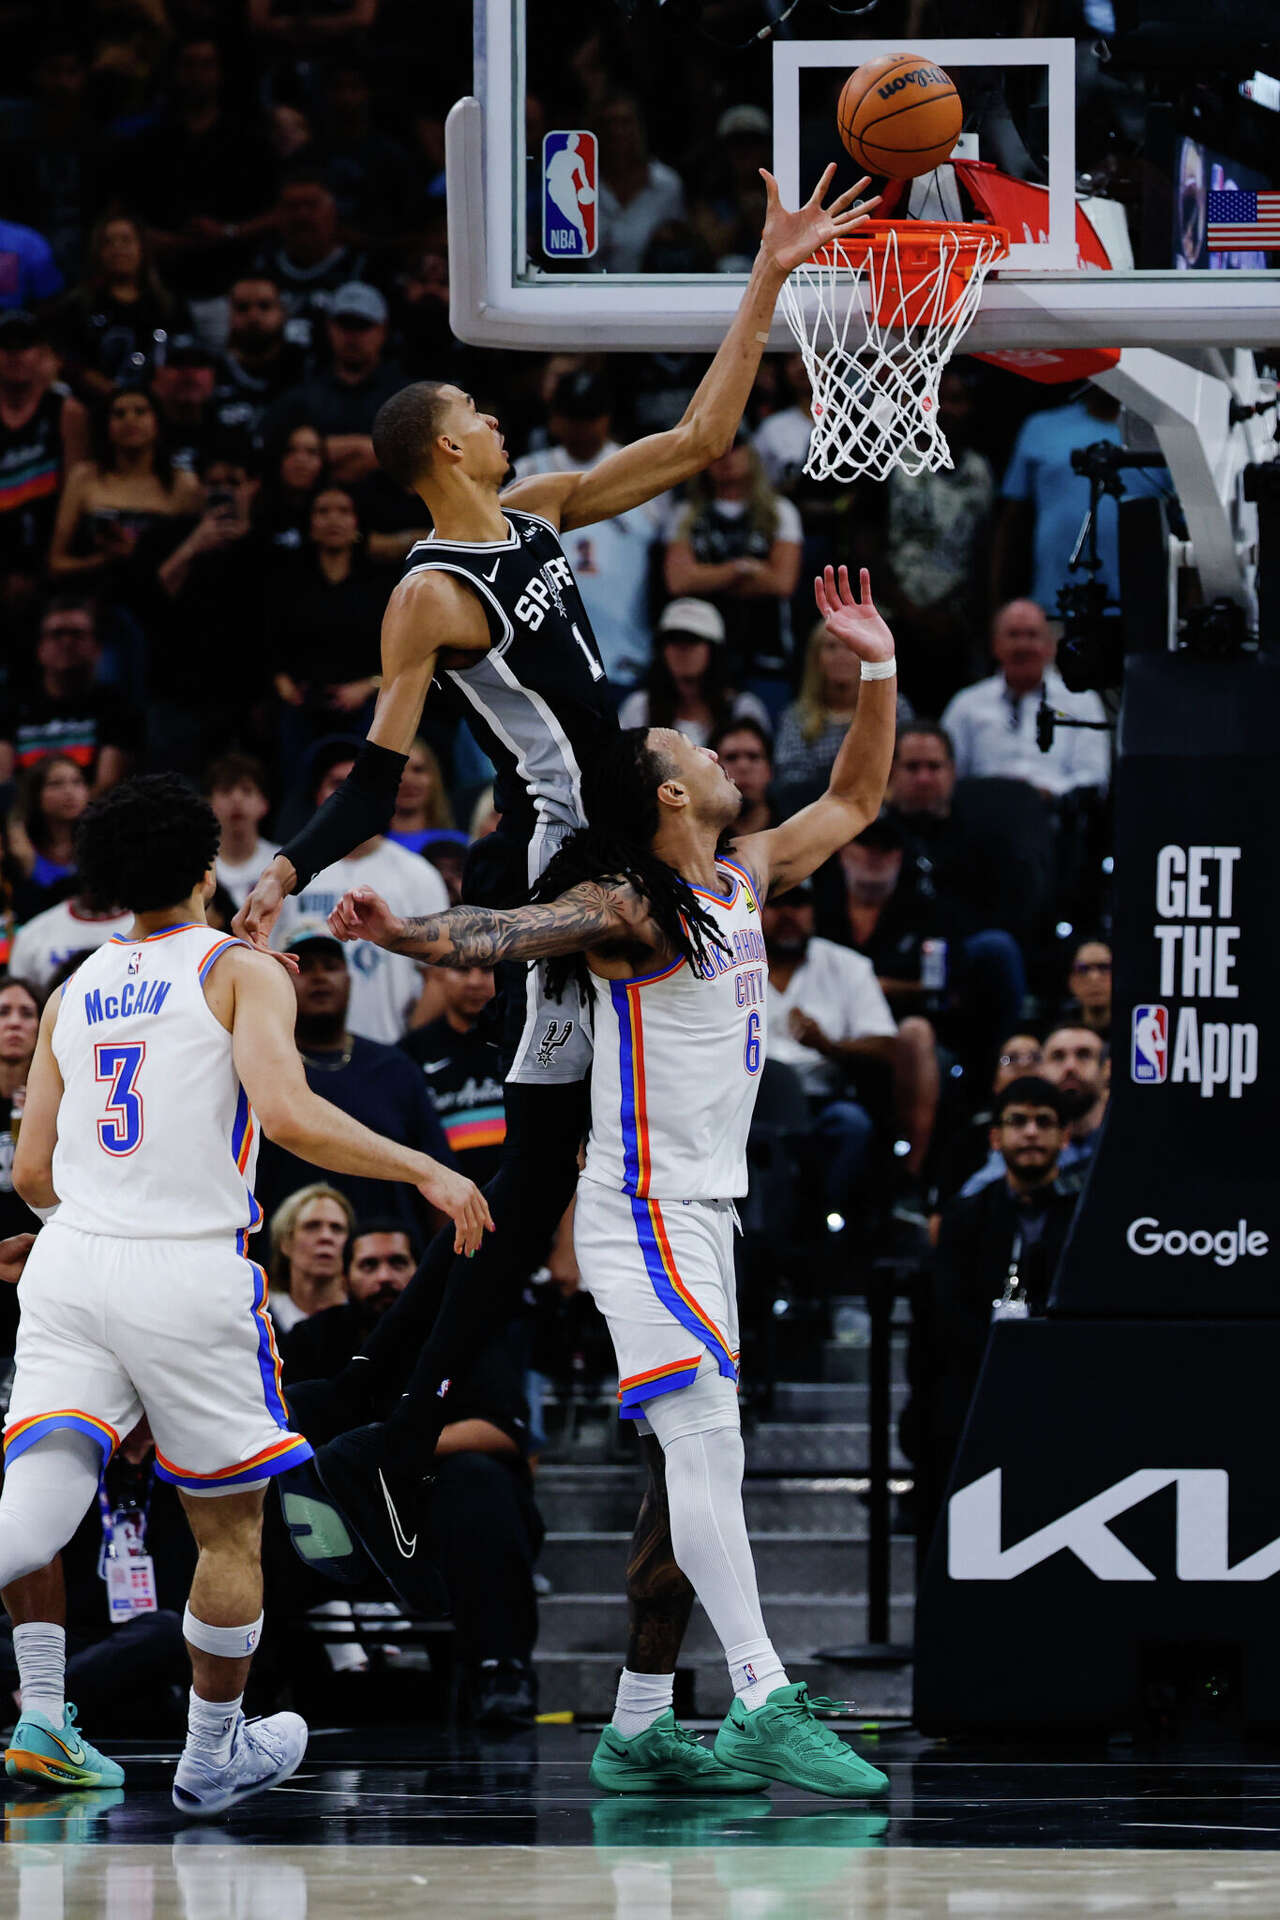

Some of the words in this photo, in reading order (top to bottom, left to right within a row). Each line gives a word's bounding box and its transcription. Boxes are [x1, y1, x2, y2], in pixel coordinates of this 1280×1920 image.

[877, 66, 953, 100] Wilson
[550, 229, 577, 249] NBA
[571, 622, 606, 682] 1
[1155, 844, 1242, 919] GET
[734, 968, 765, 1008] CITY
[1153, 924, 1241, 998] THE
[84, 979, 172, 1026] McCAIN
[742, 1008, 763, 1077] 6
[1170, 1006, 1259, 1098] App
[94, 1041, 146, 1158] 3
[1126, 1216, 1270, 1267] Google
[947, 1466, 1280, 1582] KI
